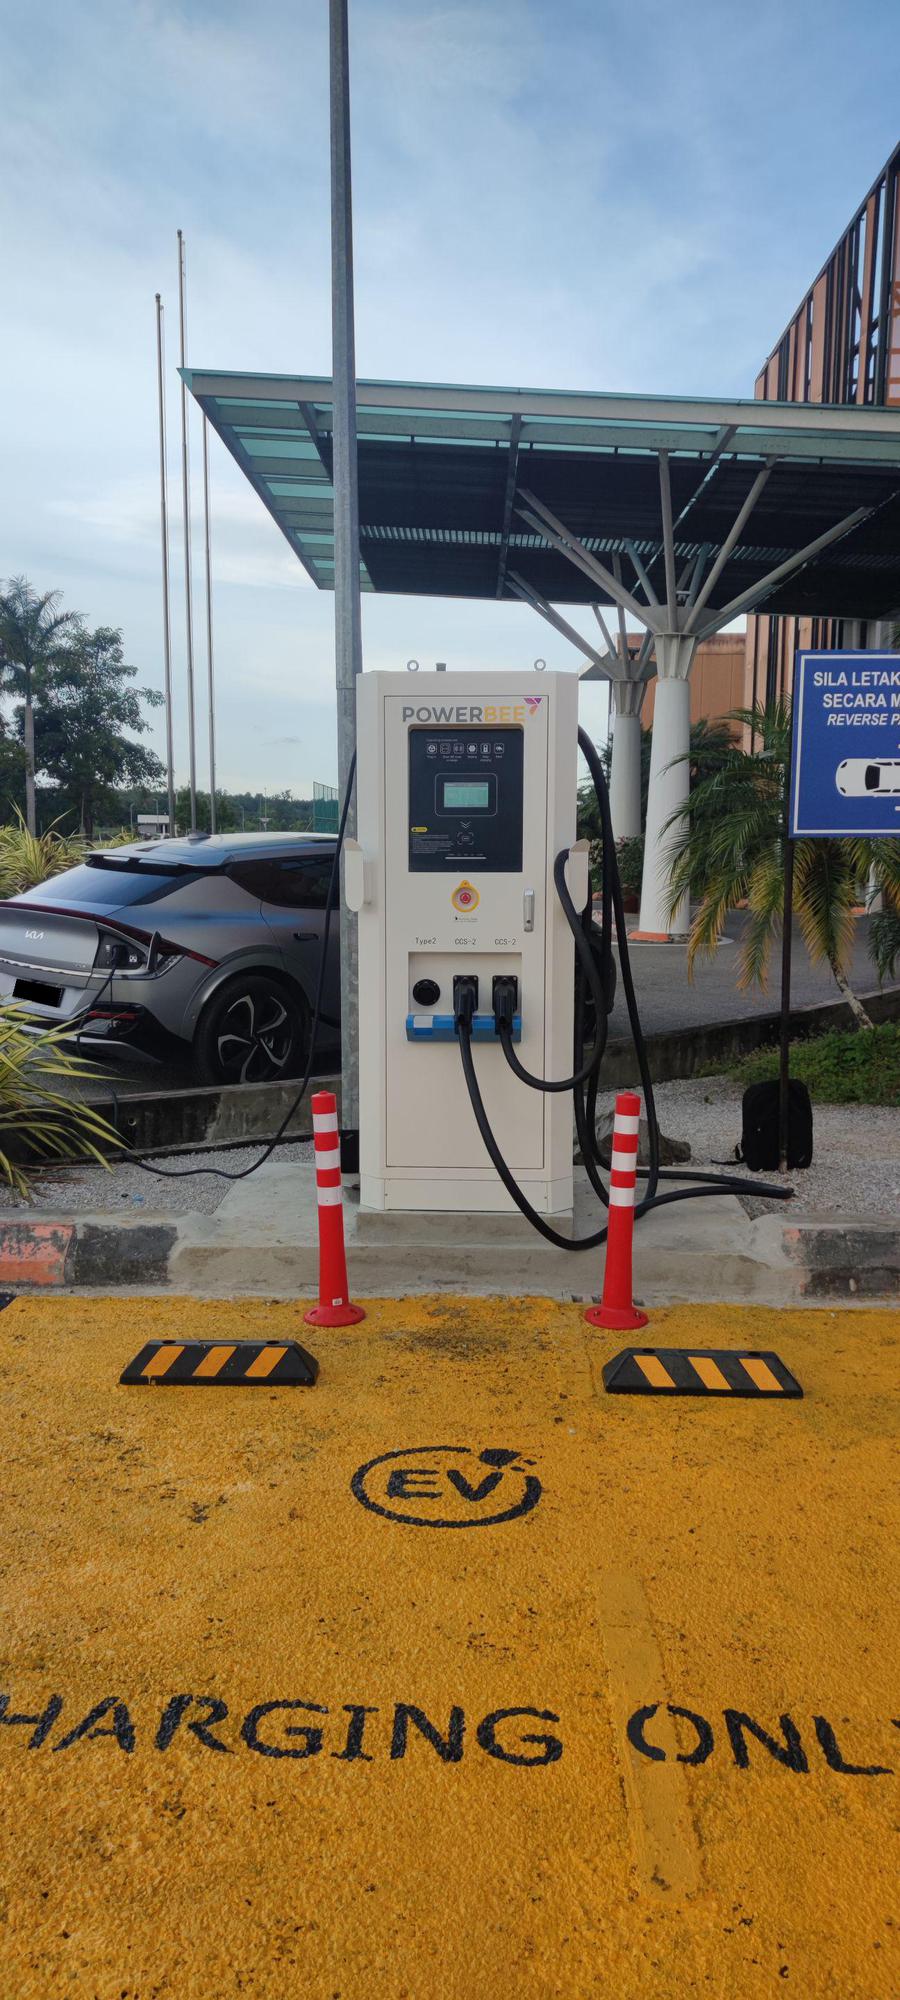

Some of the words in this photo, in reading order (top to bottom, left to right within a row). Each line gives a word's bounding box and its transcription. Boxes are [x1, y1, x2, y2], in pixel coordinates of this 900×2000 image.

[813, 671, 848, 686] SILA
[852, 671, 900, 686] LETAK
[823, 693, 887, 708] SECARA
[402, 705, 526, 723] POWERBEE
[827, 713, 888, 726] REVERSE
[890, 713, 900, 726] P
[415, 937, 437, 945] Type2
[454, 938, 477, 946] CCS-2
[494, 938, 517, 946] CCS-2
[386, 1469, 504, 1502] EV
[626, 1701, 900, 1775] ONL
